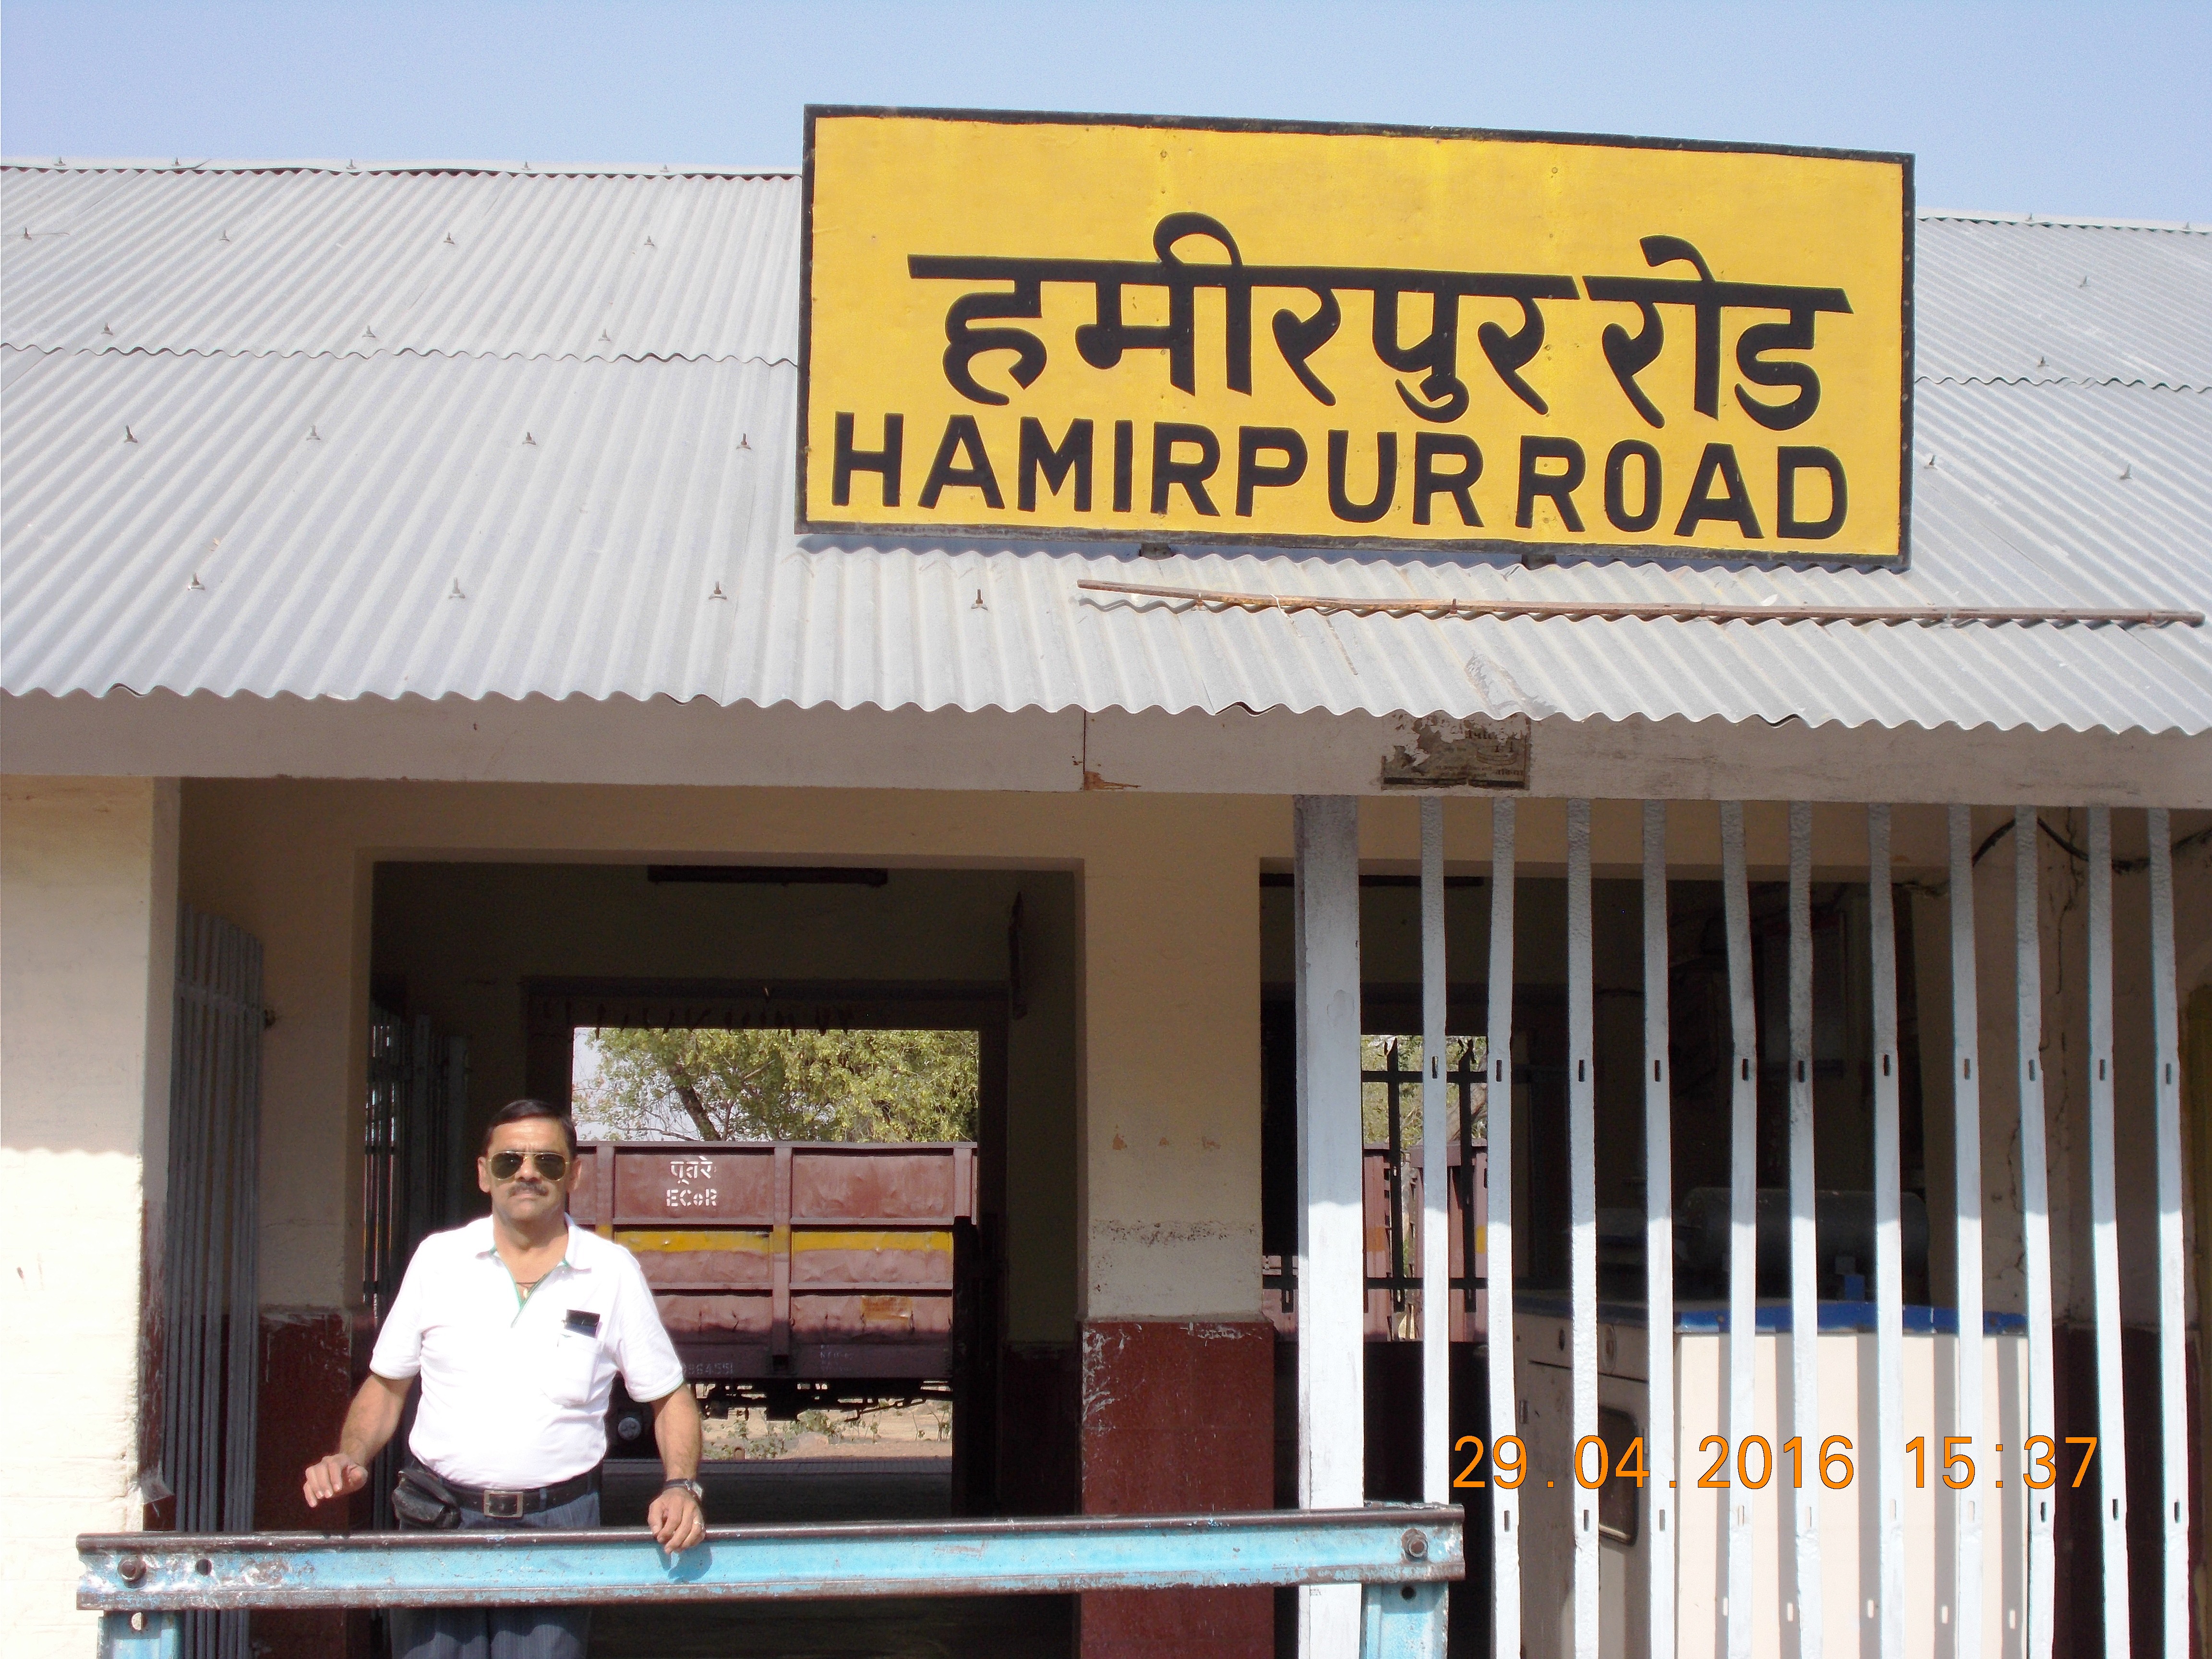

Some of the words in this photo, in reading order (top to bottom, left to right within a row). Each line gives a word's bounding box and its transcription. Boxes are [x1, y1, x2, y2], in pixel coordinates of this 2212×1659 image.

[907, 213, 1580, 424] हमीरपुर
[1582, 235, 1854, 431] रोड
[832, 412, 1484, 528] HAMIRPUR
[1515, 435, 1847, 540] ROAD
[666, 1189, 717, 1207] ECoR
